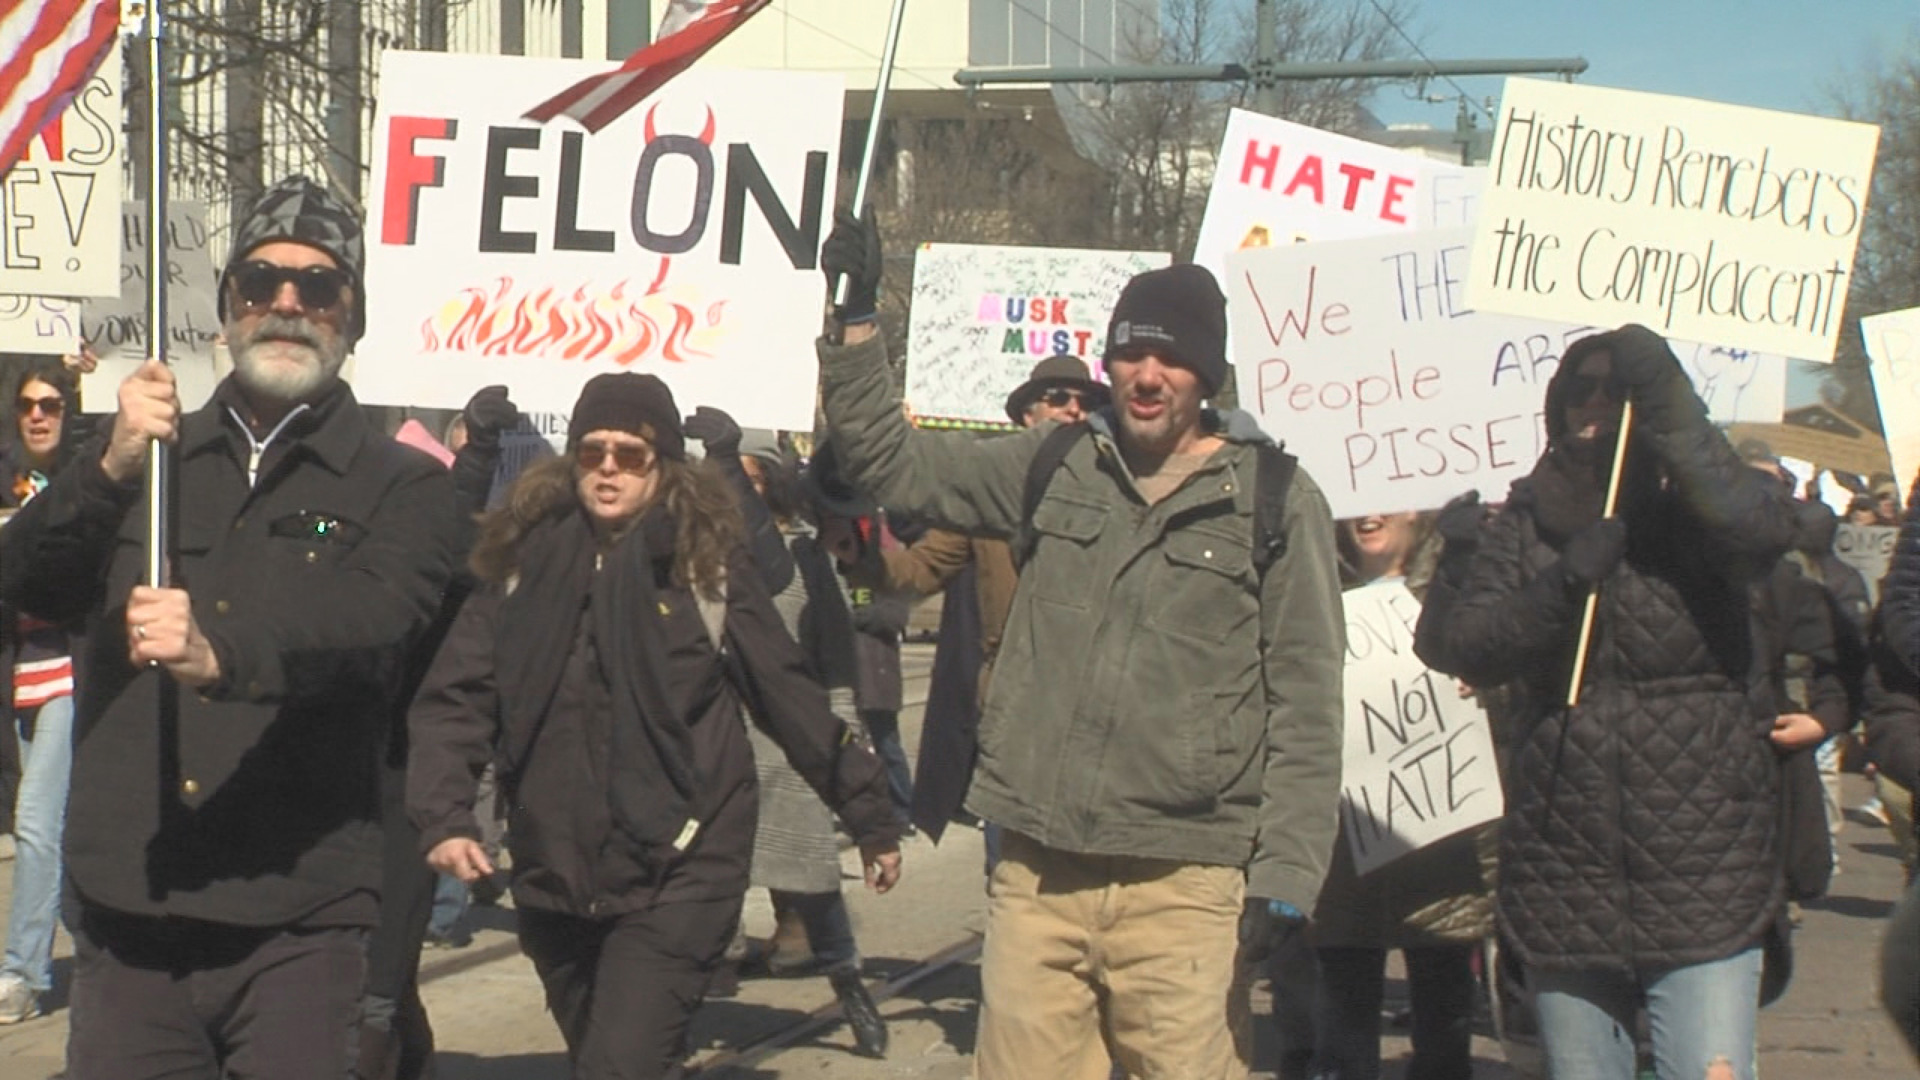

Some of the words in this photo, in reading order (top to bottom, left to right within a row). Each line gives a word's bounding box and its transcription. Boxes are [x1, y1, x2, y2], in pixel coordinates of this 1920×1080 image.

[381, 114, 829, 271] FELON
[1239, 138, 1416, 225] HATE
[1497, 106, 1645, 205] History
[1652, 125, 1858, 238] Remebers
[977, 293, 1070, 325] MUSK
[1246, 265, 1353, 347] We
[1381, 246, 1477, 322] THE
[1493, 217, 1561, 295] the
[1577, 228, 1847, 330] Complacent
[1001, 328, 1092, 356] MUST
[1257, 349, 1442, 429] People
